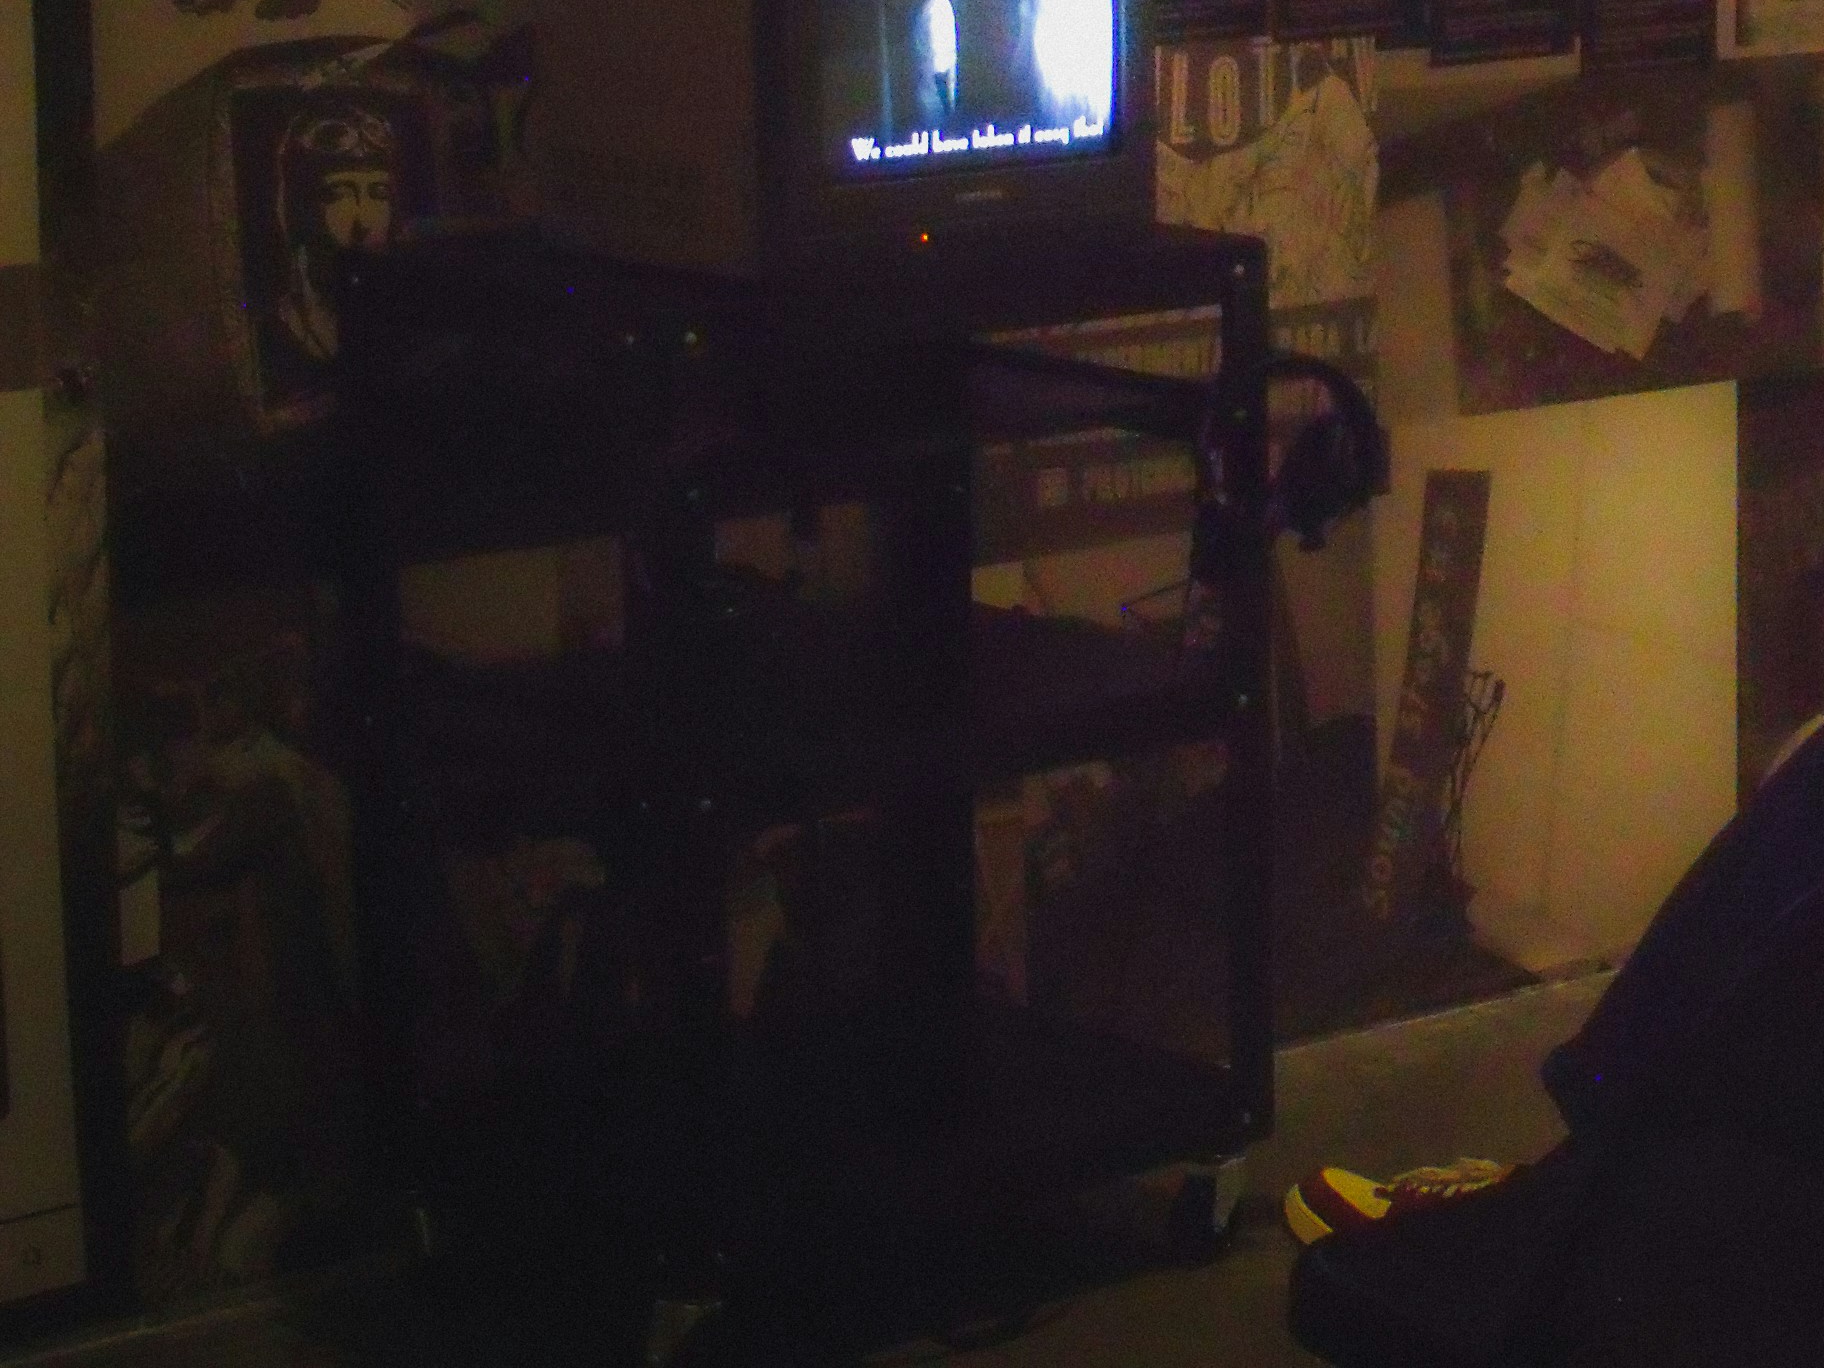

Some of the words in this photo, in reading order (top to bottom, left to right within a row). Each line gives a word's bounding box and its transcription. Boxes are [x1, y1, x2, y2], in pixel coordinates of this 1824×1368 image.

[851, 137, 881, 160] We
[885, 131, 929, 157] could
[933, 129, 969, 152] have
[973, 124, 1015, 148] taken
[1018, 124, 1031, 143] it
